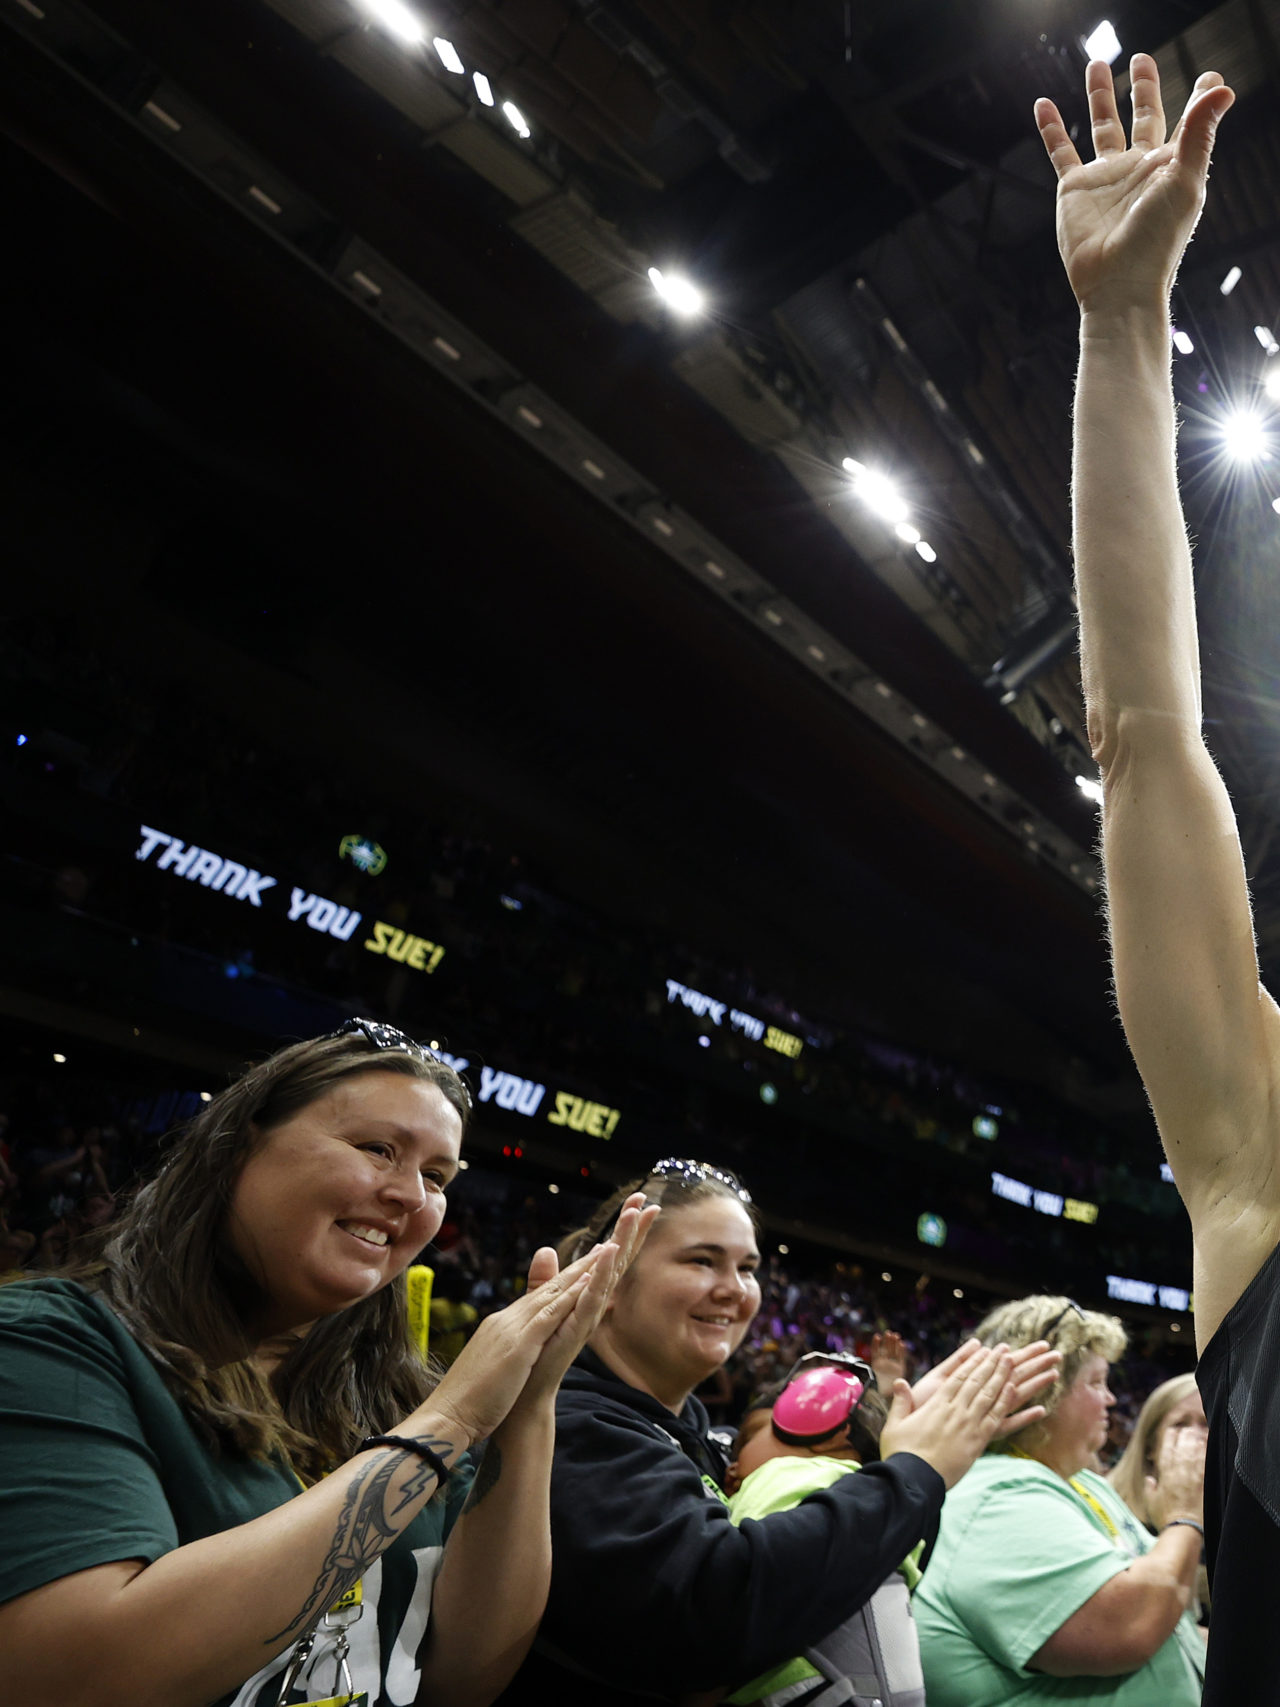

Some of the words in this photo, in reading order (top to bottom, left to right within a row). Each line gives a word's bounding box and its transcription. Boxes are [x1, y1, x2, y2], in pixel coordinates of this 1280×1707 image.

[135, 825, 277, 907] THANK
[287, 886, 361, 941] YOU
[364, 921, 445, 973] SUE!
[477, 1065, 546, 1117] YOU
[547, 1091, 620, 1140] SUE!
